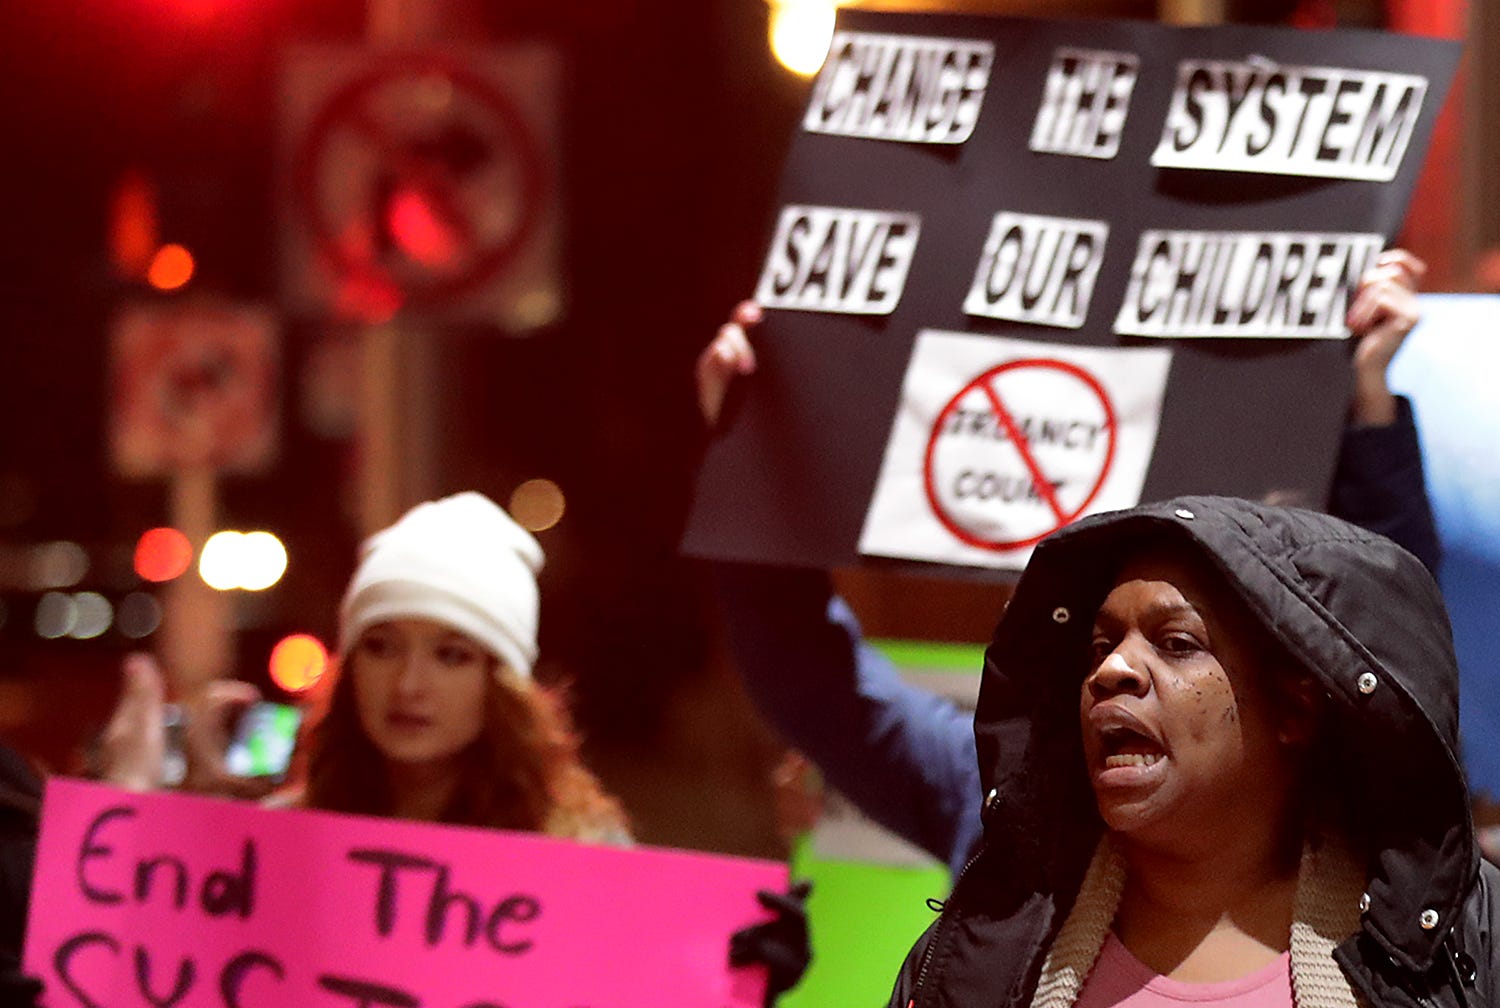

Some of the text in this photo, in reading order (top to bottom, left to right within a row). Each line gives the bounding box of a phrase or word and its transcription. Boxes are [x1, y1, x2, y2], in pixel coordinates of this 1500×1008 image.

[815, 43, 1415, 166] CHANGE THE SYSTEM
[772, 215, 1373, 326] SAVE OUR CHILDREN
[77, 805, 542, 955] End The
